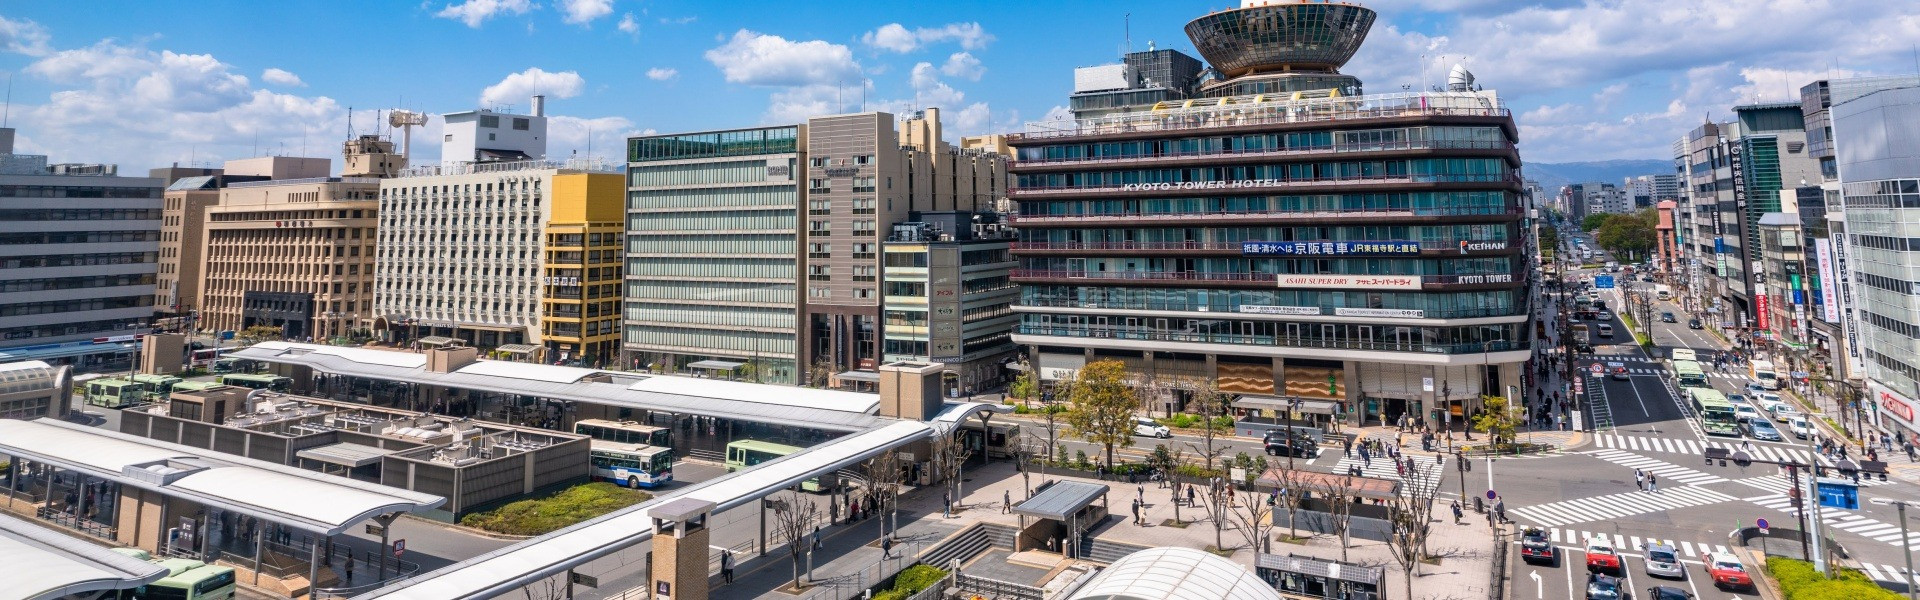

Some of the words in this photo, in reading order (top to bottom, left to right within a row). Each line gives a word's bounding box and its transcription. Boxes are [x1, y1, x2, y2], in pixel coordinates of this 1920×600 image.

[1123, 182, 1171, 191] KYOTO
[1175, 180, 1227, 190] TOWER
[1231, 178, 1283, 188] HOTEL
[1294, 242, 1349, 255] 京阪電車
[1350, 243, 1418, 253] JR東福寺駅と直結
[1468, 242, 1505, 251] KEIHAN
[1285, 277, 1308, 285] ASAHI
[1458, 275, 1484, 285] KYOTO
[1485, 274, 1512, 283] TOWER
